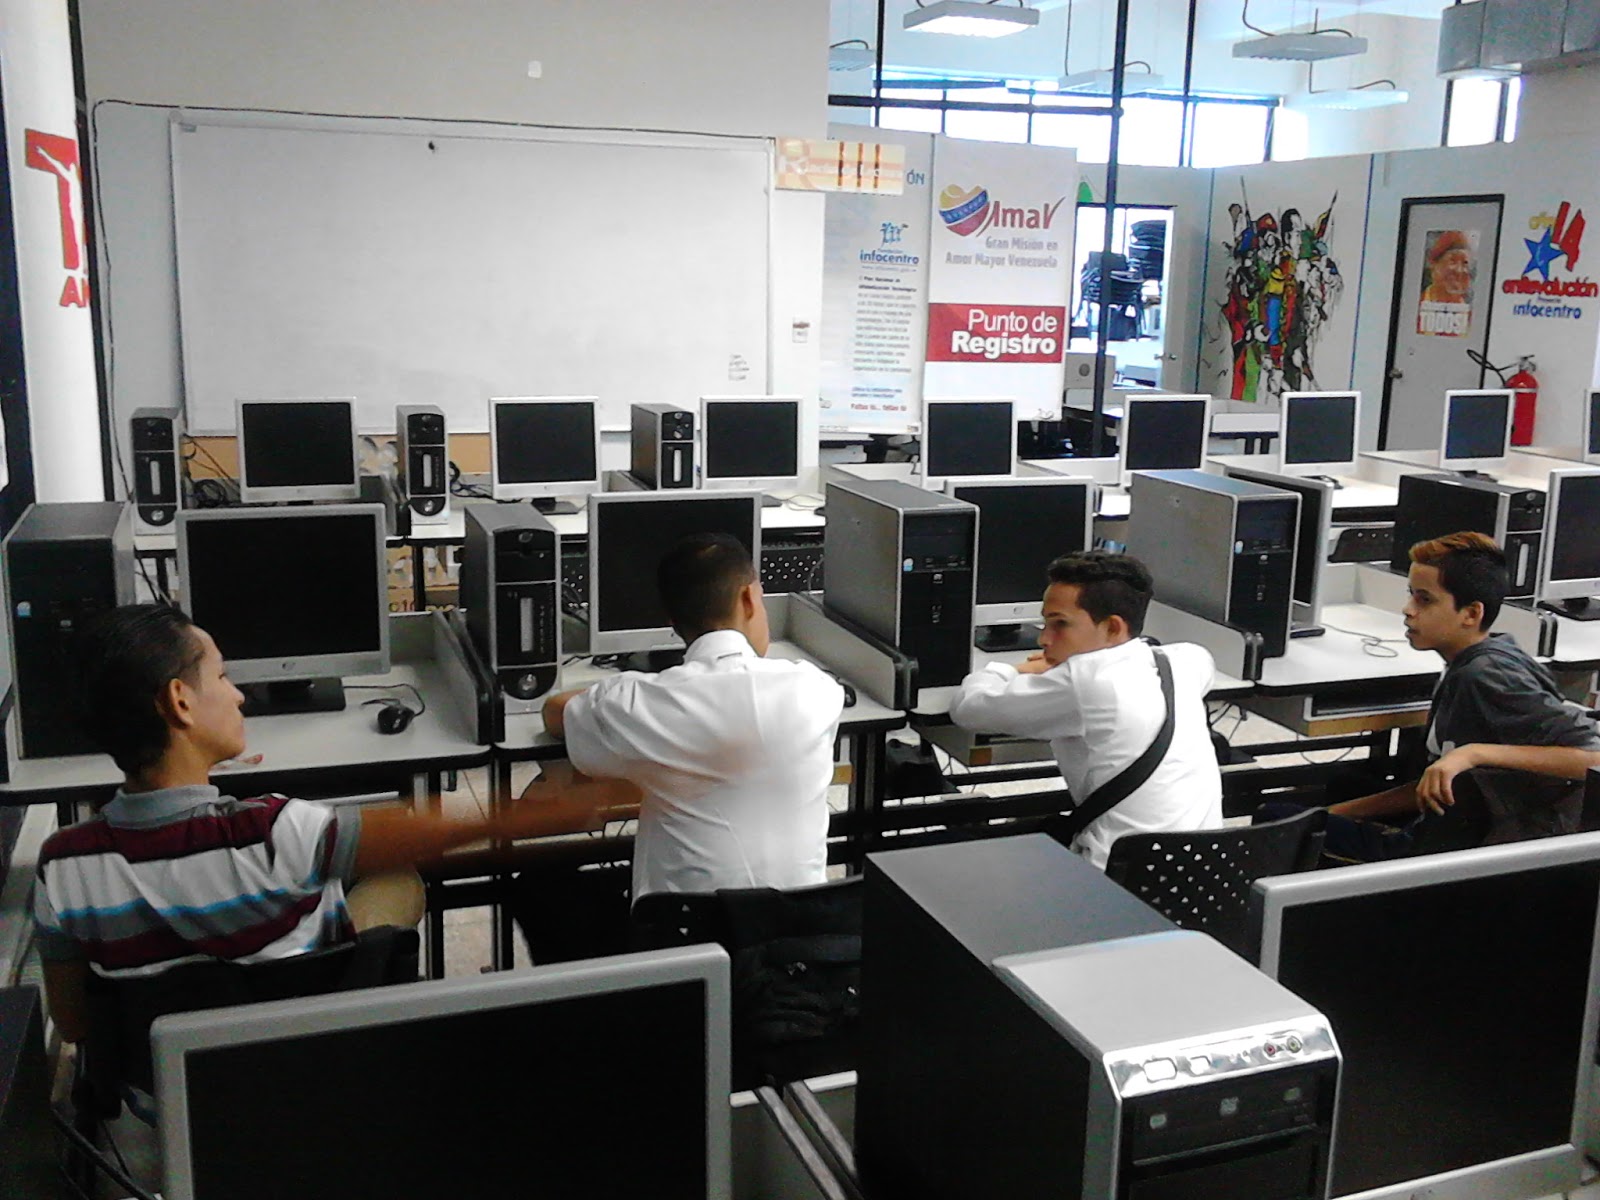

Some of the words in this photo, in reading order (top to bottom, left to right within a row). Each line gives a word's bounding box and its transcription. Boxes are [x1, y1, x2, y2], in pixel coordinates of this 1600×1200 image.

[986, 236, 1009, 249] Gran
[1047, 241, 1058, 250] en
[859, 249, 920, 265] infocentro
[975, 254, 1006, 269] Mayor
[1008, 254, 1058, 268] Venezuela
[1513, 300, 1582, 319] infocentro
[967, 308, 1028, 332] Punto
[1031, 310, 1058, 333] de
[950, 330, 1057, 359] Registro
